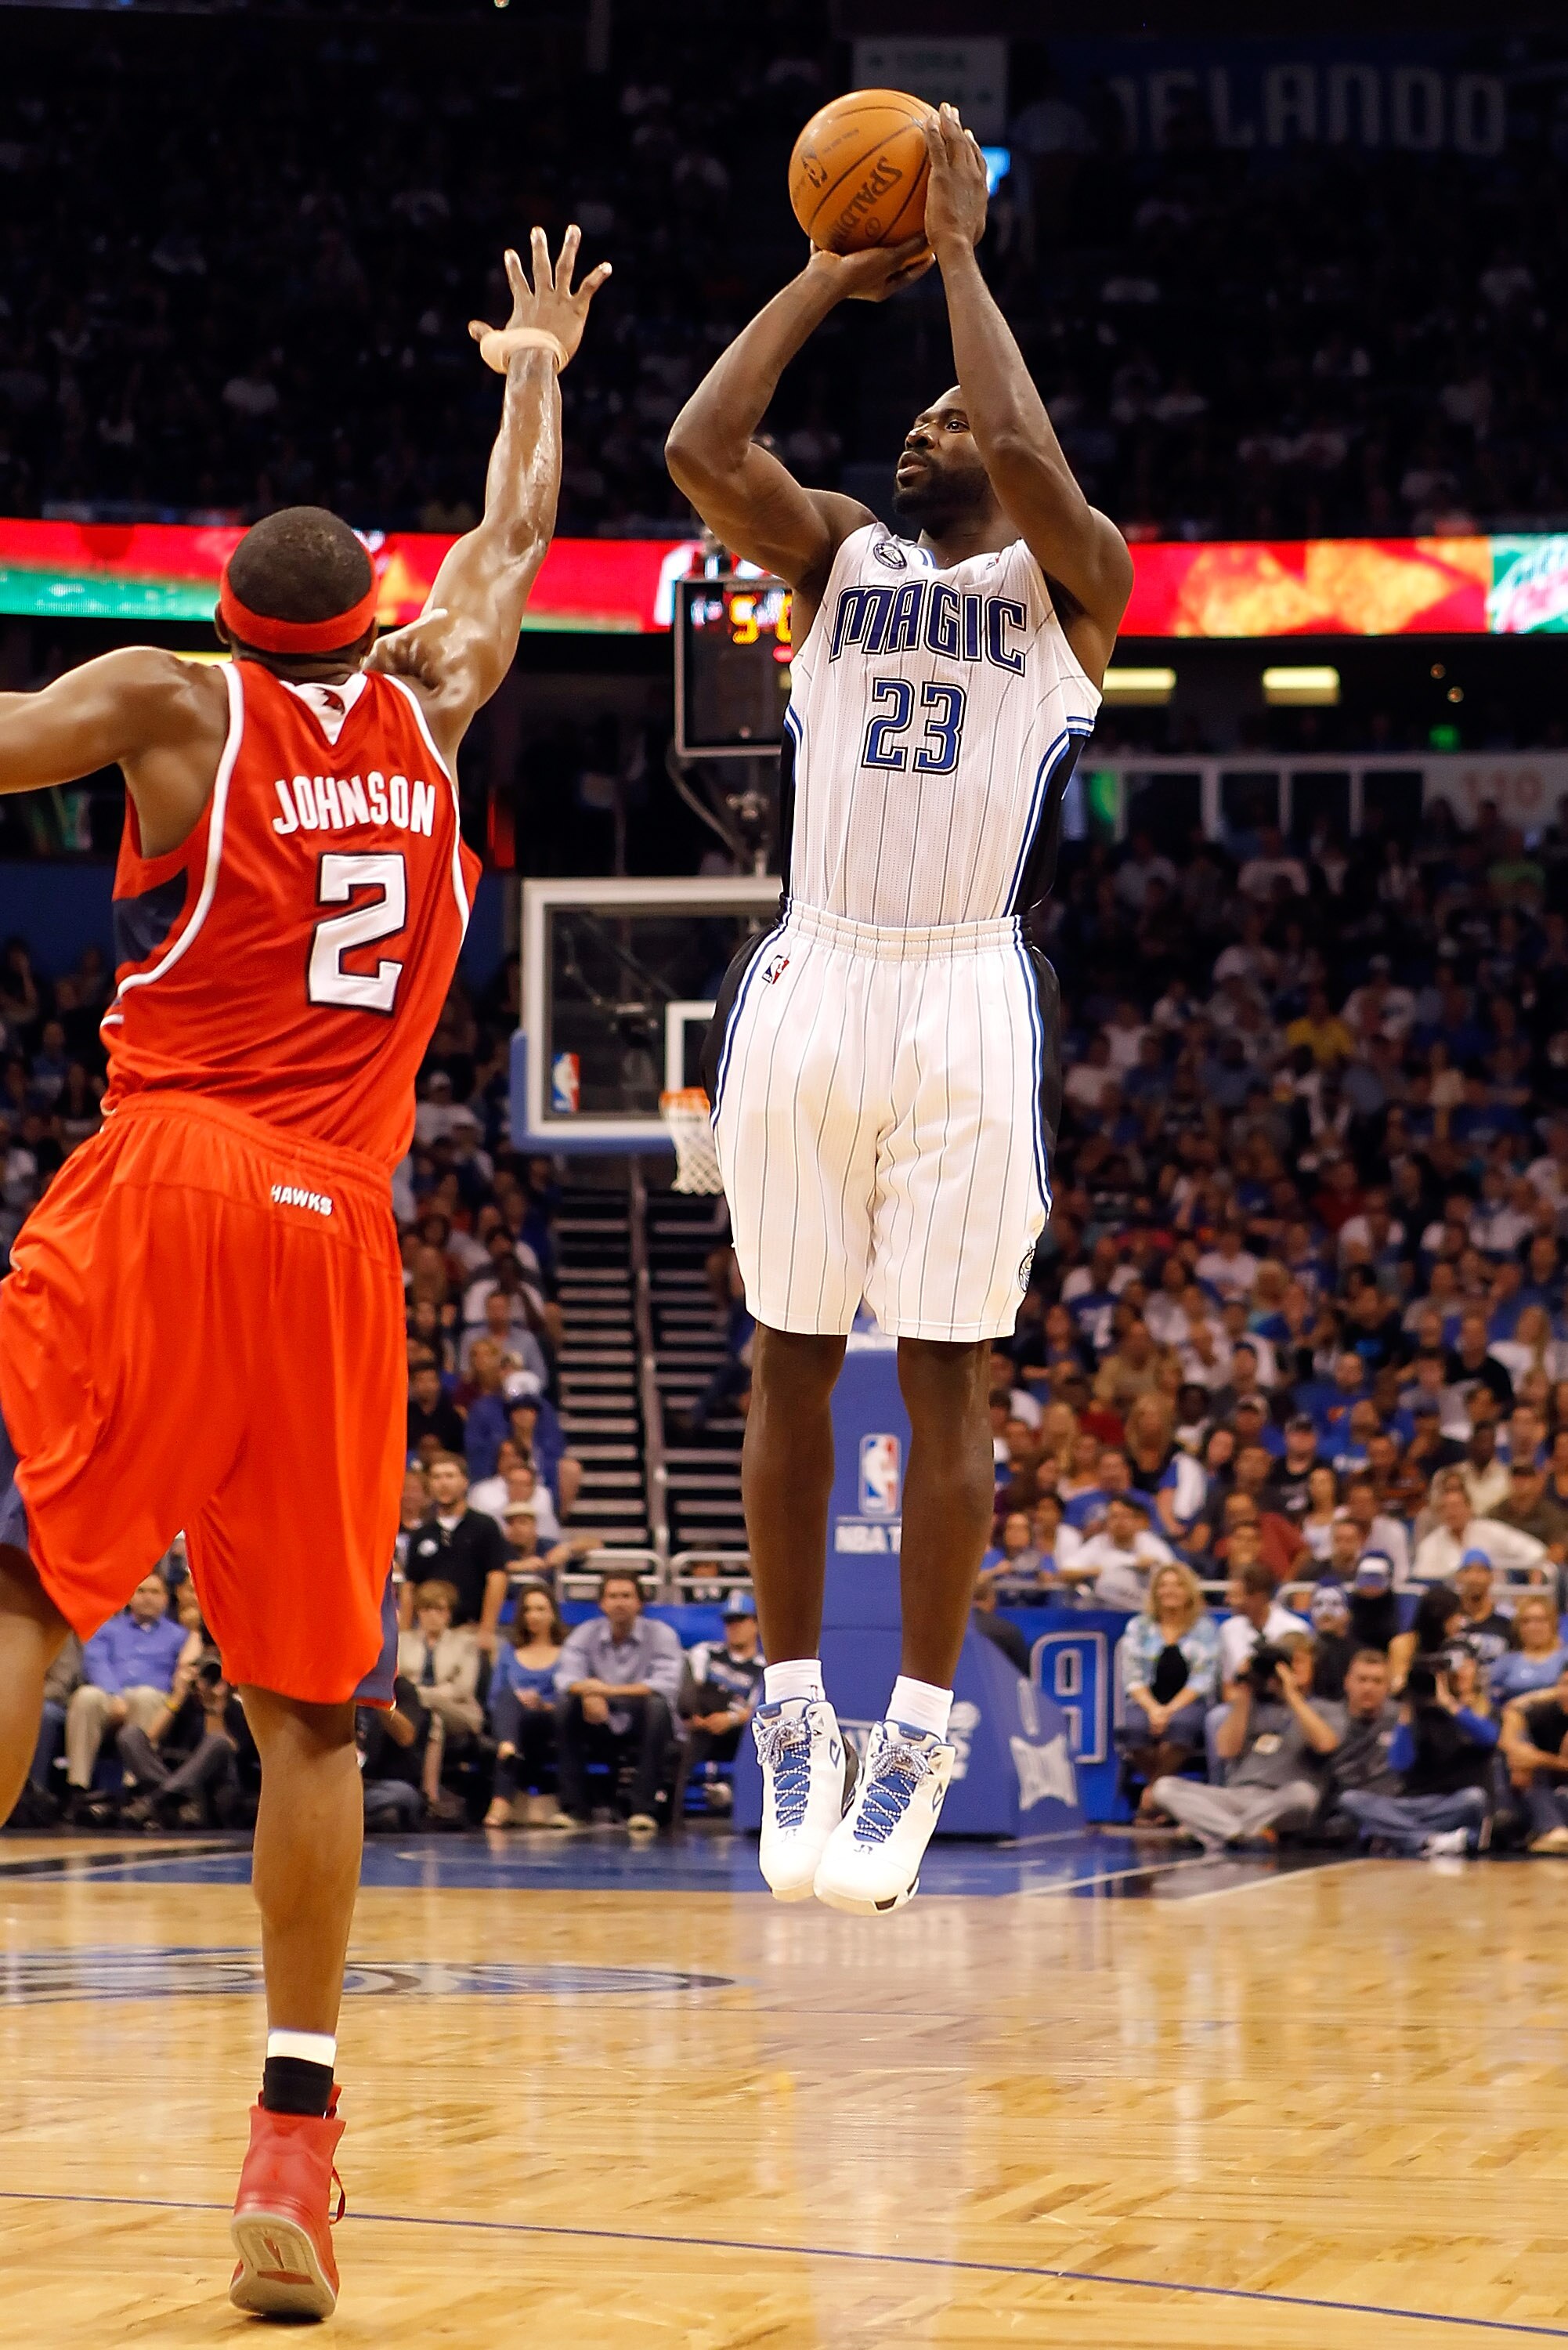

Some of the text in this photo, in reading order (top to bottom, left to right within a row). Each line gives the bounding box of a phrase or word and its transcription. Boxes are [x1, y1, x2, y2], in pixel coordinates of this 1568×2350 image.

[1108, 63, 1506, 157] LANDO
[827, 155, 903, 251] SPALDIN
[829, 580, 1026, 677] MAGIC
[862, 677, 966, 775] 23
[273, 771, 435, 837] JOHNSON
[306, 851, 408, 1014] 2
[270, 1184, 334, 1217] HAWKS
